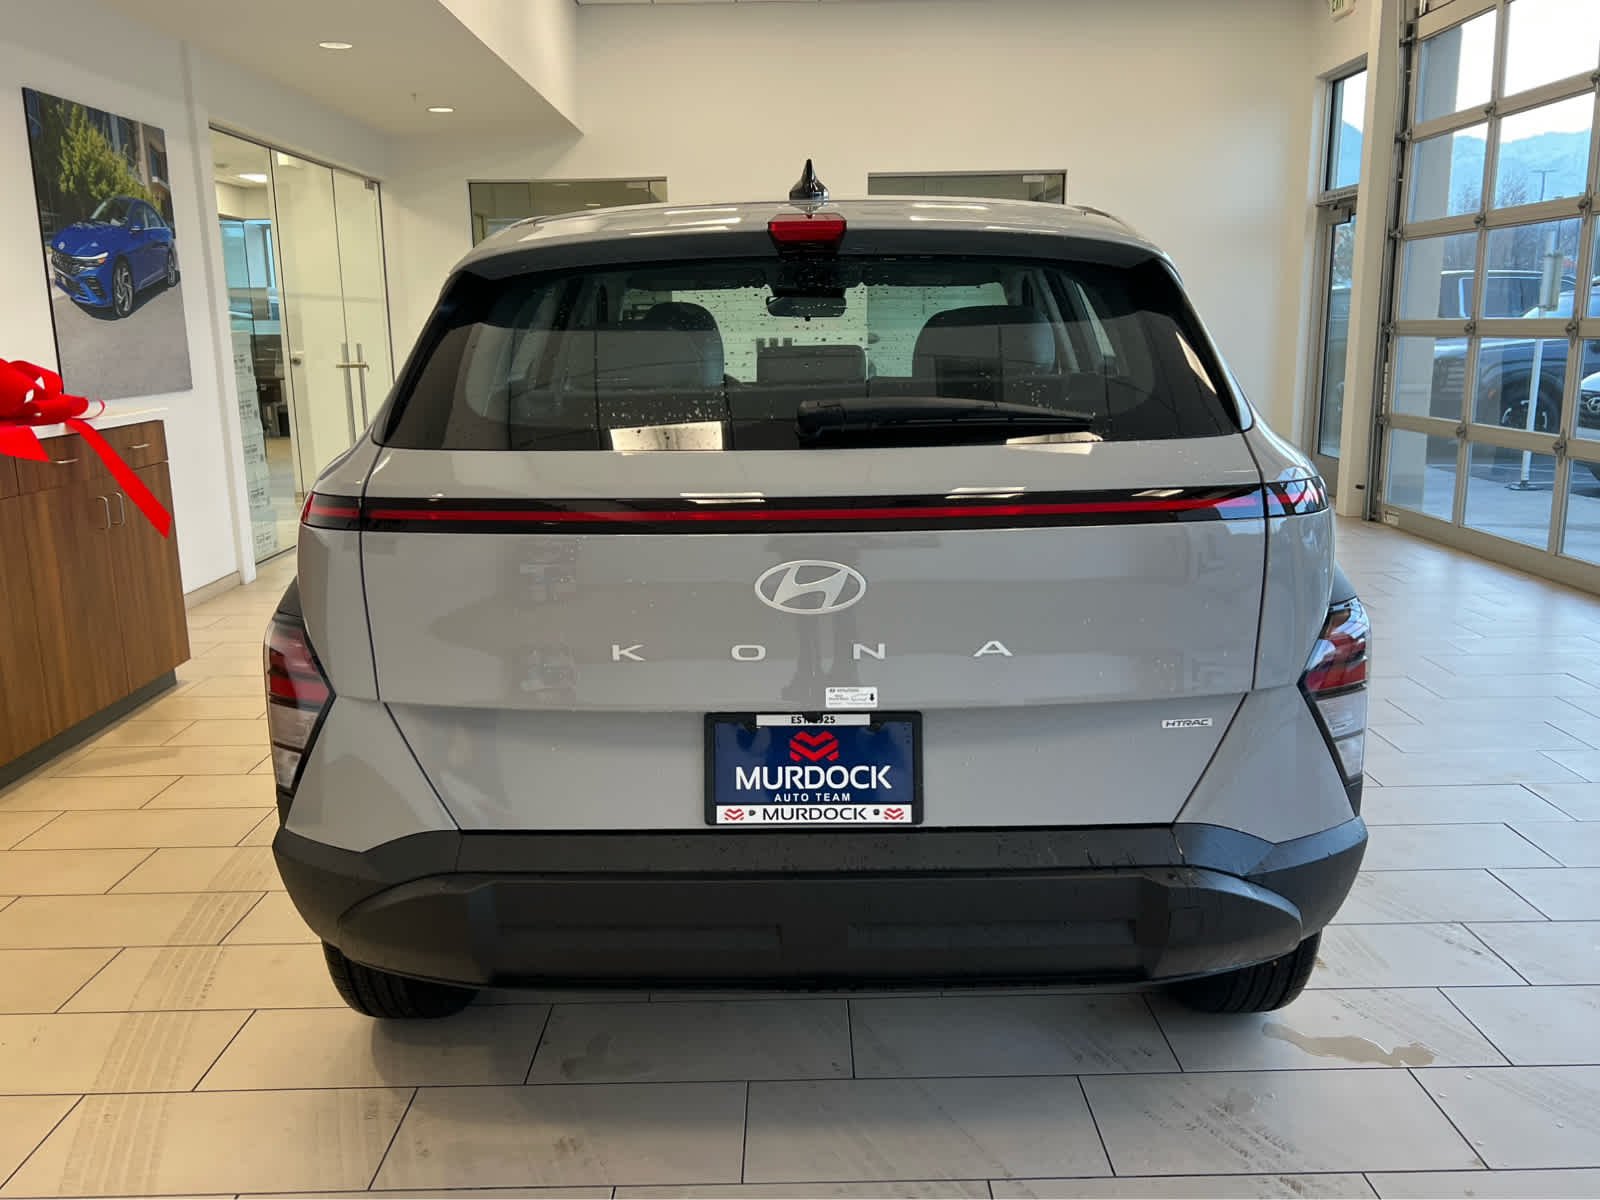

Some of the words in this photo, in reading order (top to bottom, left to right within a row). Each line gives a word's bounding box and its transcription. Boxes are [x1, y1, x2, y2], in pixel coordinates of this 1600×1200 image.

[611, 640, 1013, 662] KONA
[1166, 719, 1209, 727] HTRAC
[735, 765, 893, 790] MURDOCK
[774, 793, 809, 802] AUTO
[815, 793, 851, 802] TEAM
[762, 807, 867, 821] MURDOCK
